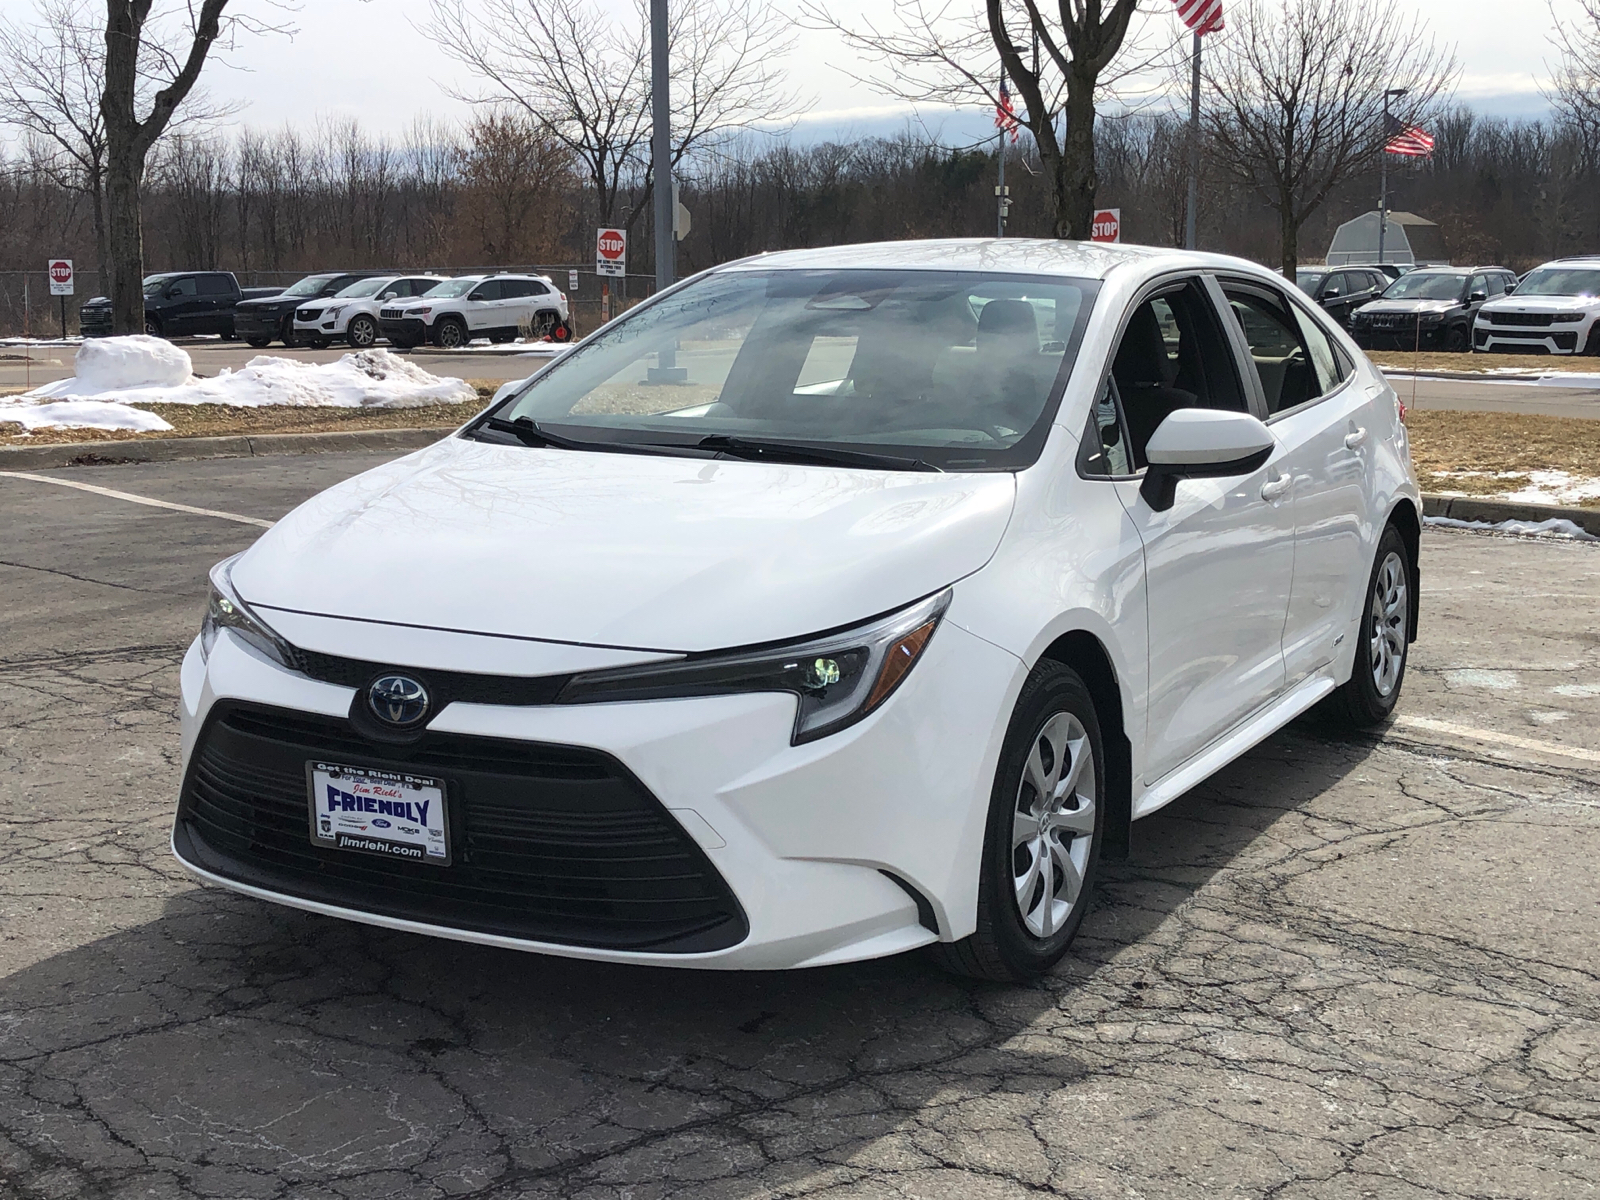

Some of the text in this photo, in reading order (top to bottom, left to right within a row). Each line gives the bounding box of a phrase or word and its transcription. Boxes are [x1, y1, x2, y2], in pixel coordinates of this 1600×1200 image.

[1092, 222, 1117, 237] STOP
[600, 239, 624, 251] STOP
[51, 268, 71, 277] STOP
[317, 763, 434, 786] Get the Riehl Deal
[353, 784, 402, 799] Jim Riehl's
[327, 784, 430, 828] FRIENDLY
[339, 836, 422, 858] jimriehl.com
